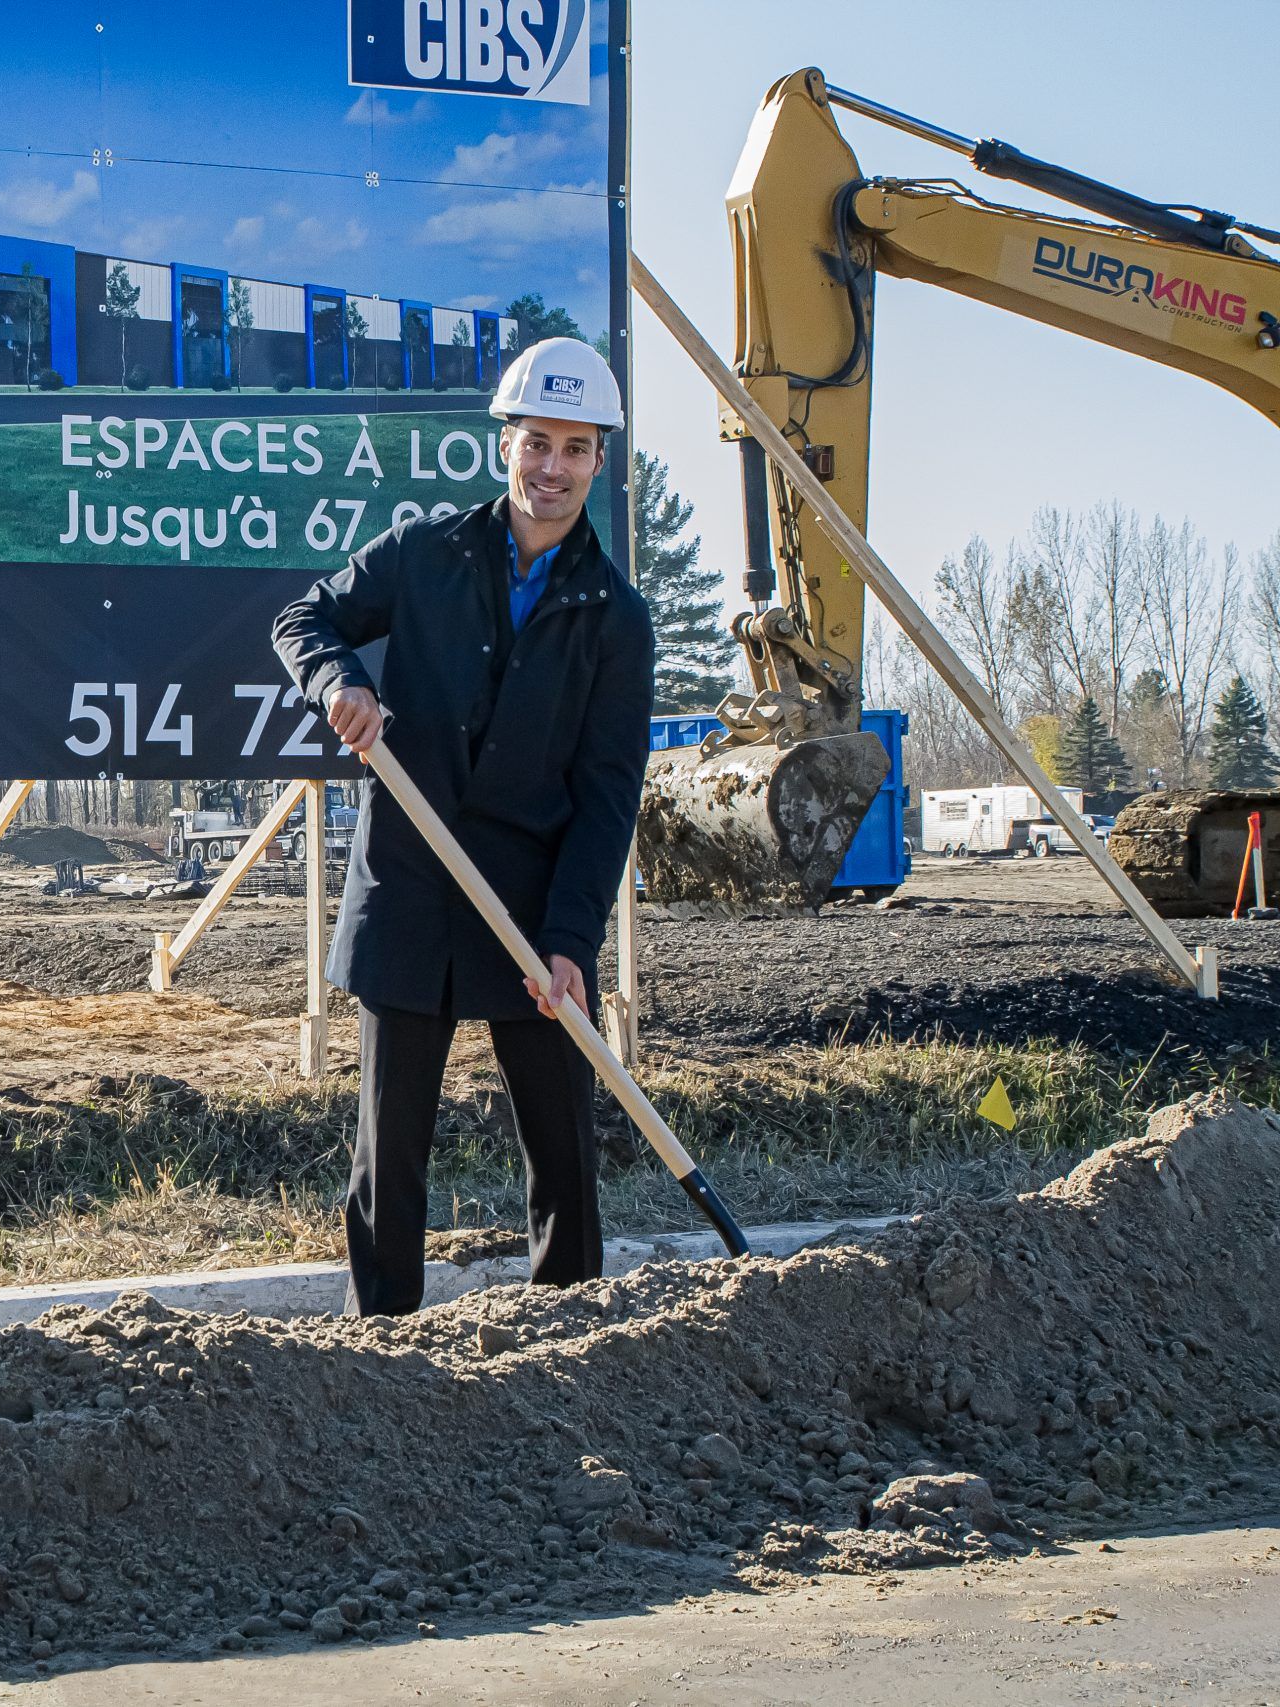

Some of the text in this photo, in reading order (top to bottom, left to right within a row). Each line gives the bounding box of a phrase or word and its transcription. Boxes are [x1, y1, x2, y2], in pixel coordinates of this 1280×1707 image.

[403, 0, 545, 87] CIBS
[1033, 236, 1248, 326] DUROKING
[1161, 304, 1243, 334] CONSTRUCTION
[552, 378, 576, 393] CIBS
[61, 414, 323, 475] ESPACES
[344, 414, 385, 479] À
[59, 490, 278, 561] Jusqu'à
[304, 498, 367, 552] 67
[65, 683, 352, 756] 514 72
